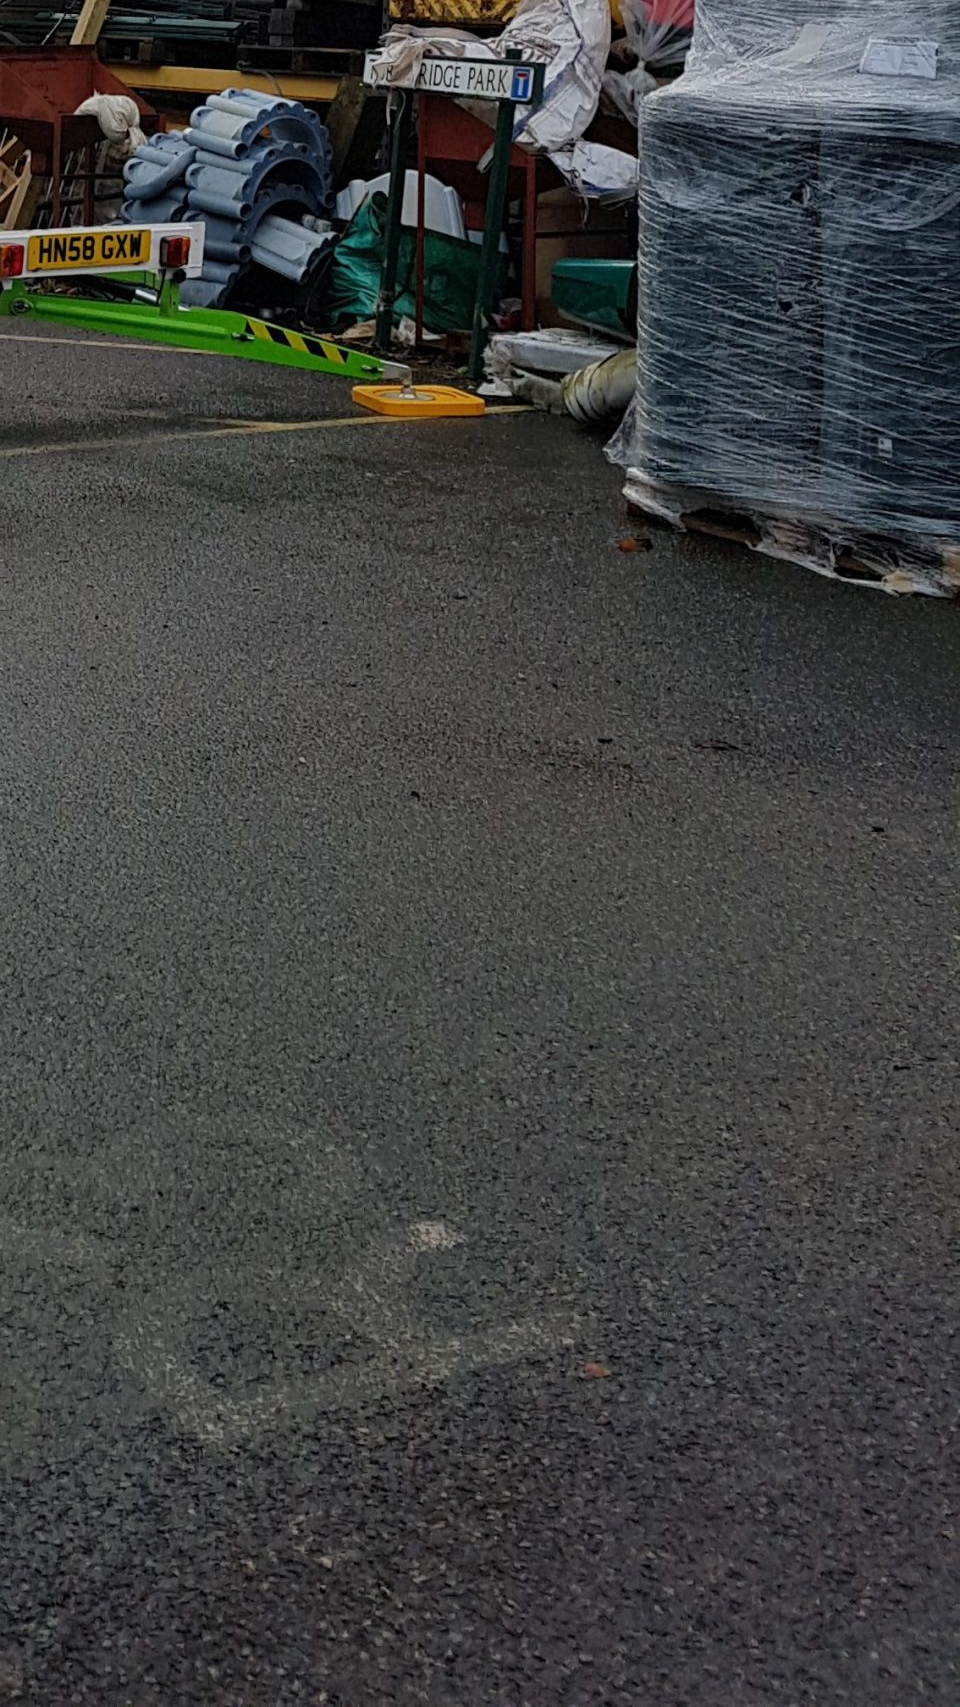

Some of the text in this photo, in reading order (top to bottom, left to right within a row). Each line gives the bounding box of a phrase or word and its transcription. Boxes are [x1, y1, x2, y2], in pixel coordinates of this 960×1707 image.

[418, 62, 462, 89] RIDGE
[467, 66, 508, 93] PARK
[39, 233, 142, 263] HN58 GXW
